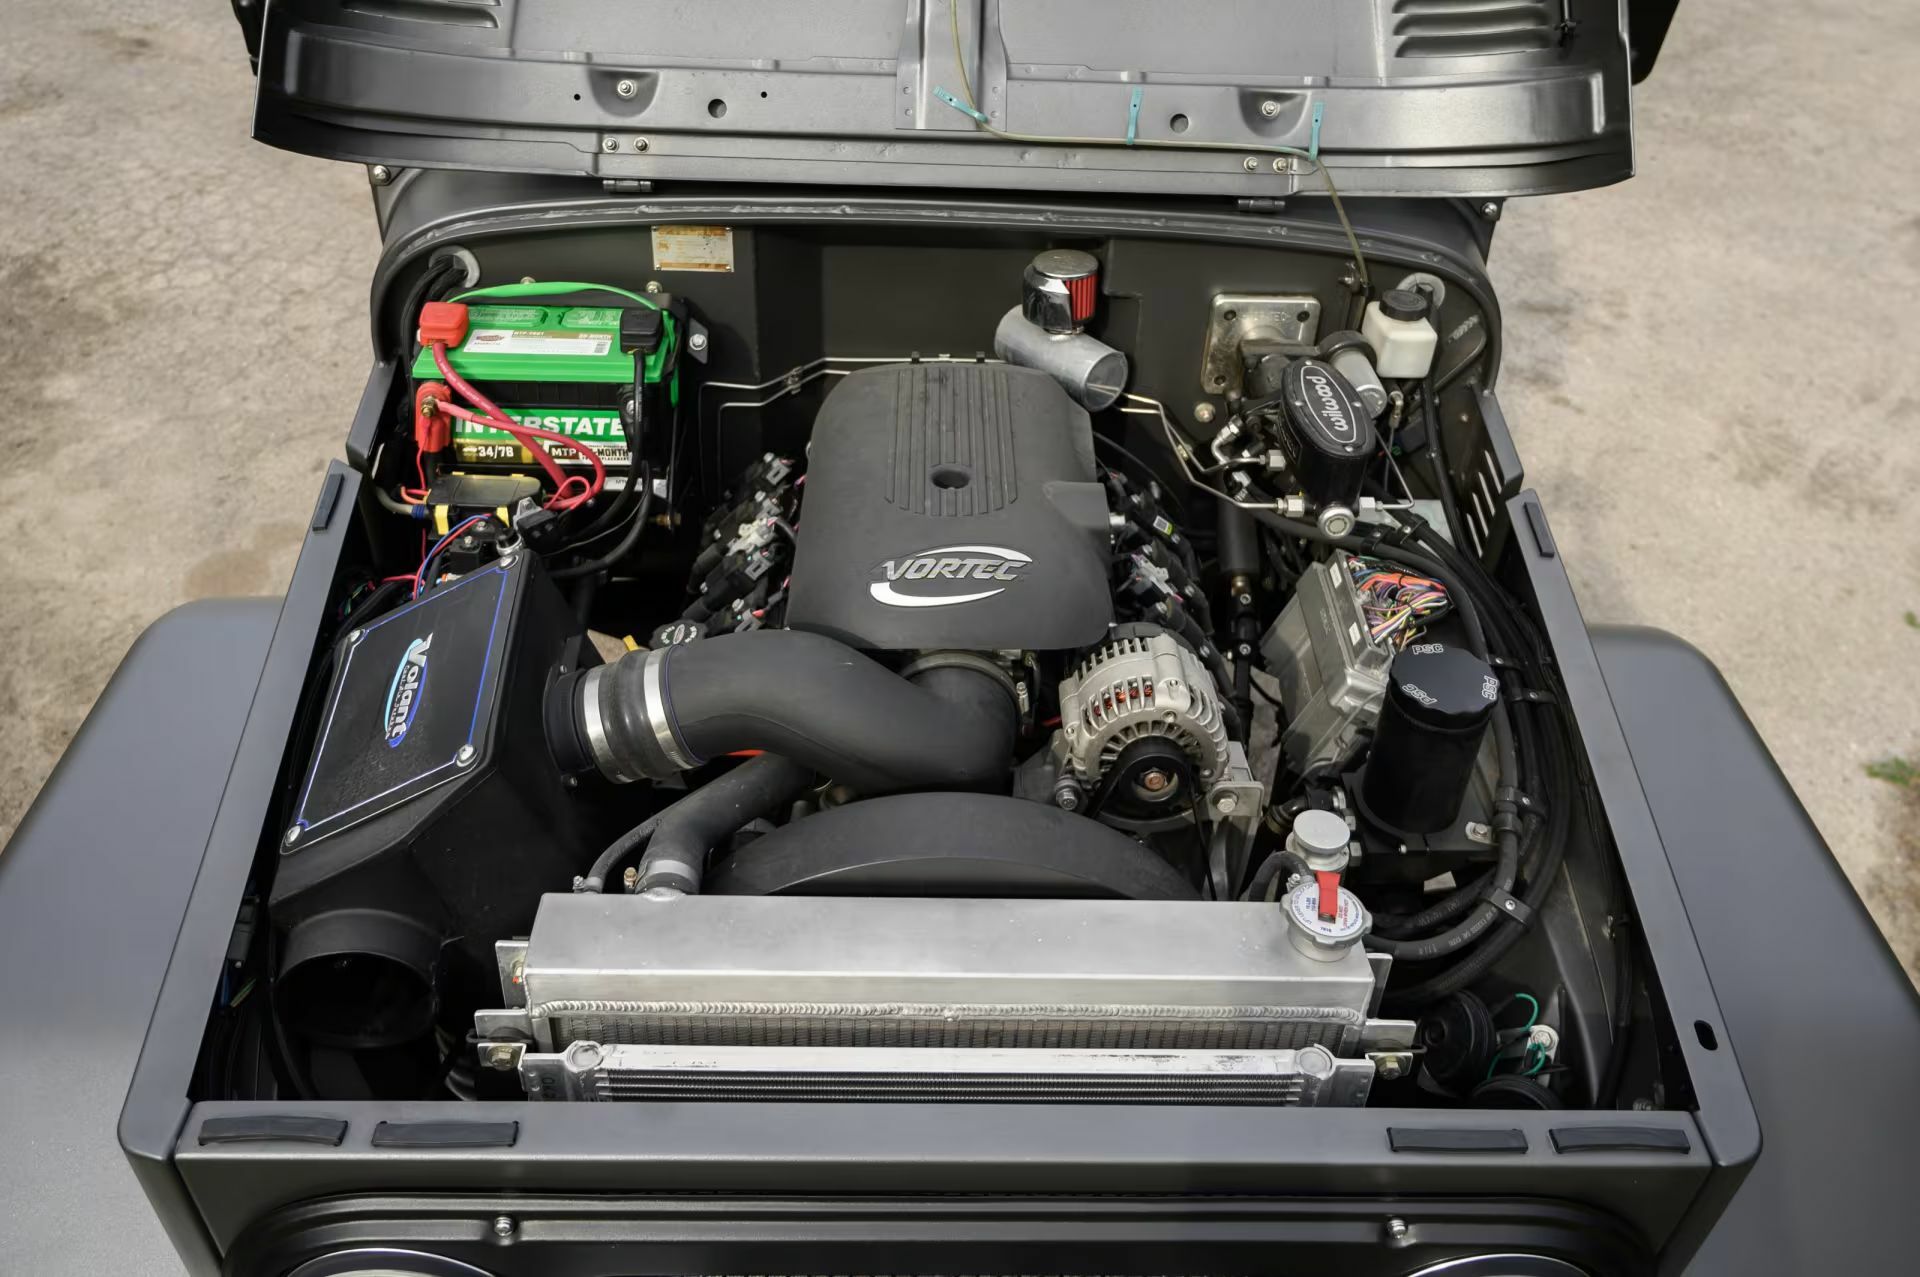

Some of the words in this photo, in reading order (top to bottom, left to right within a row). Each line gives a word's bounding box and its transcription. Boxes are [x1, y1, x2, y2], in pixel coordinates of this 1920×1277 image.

[1306, 376, 1348, 431] wilwood
[455, 415, 625, 435] INRSTATE
[551, 448, 577, 457] MTP
[882, 558, 1027, 580] VORTEC
[1412, 643, 1444, 655] PSC
[391, 631, 434, 738] Volant
[1402, 683, 1438, 705] PSC
[1481, 675, 1498, 701] PSC
